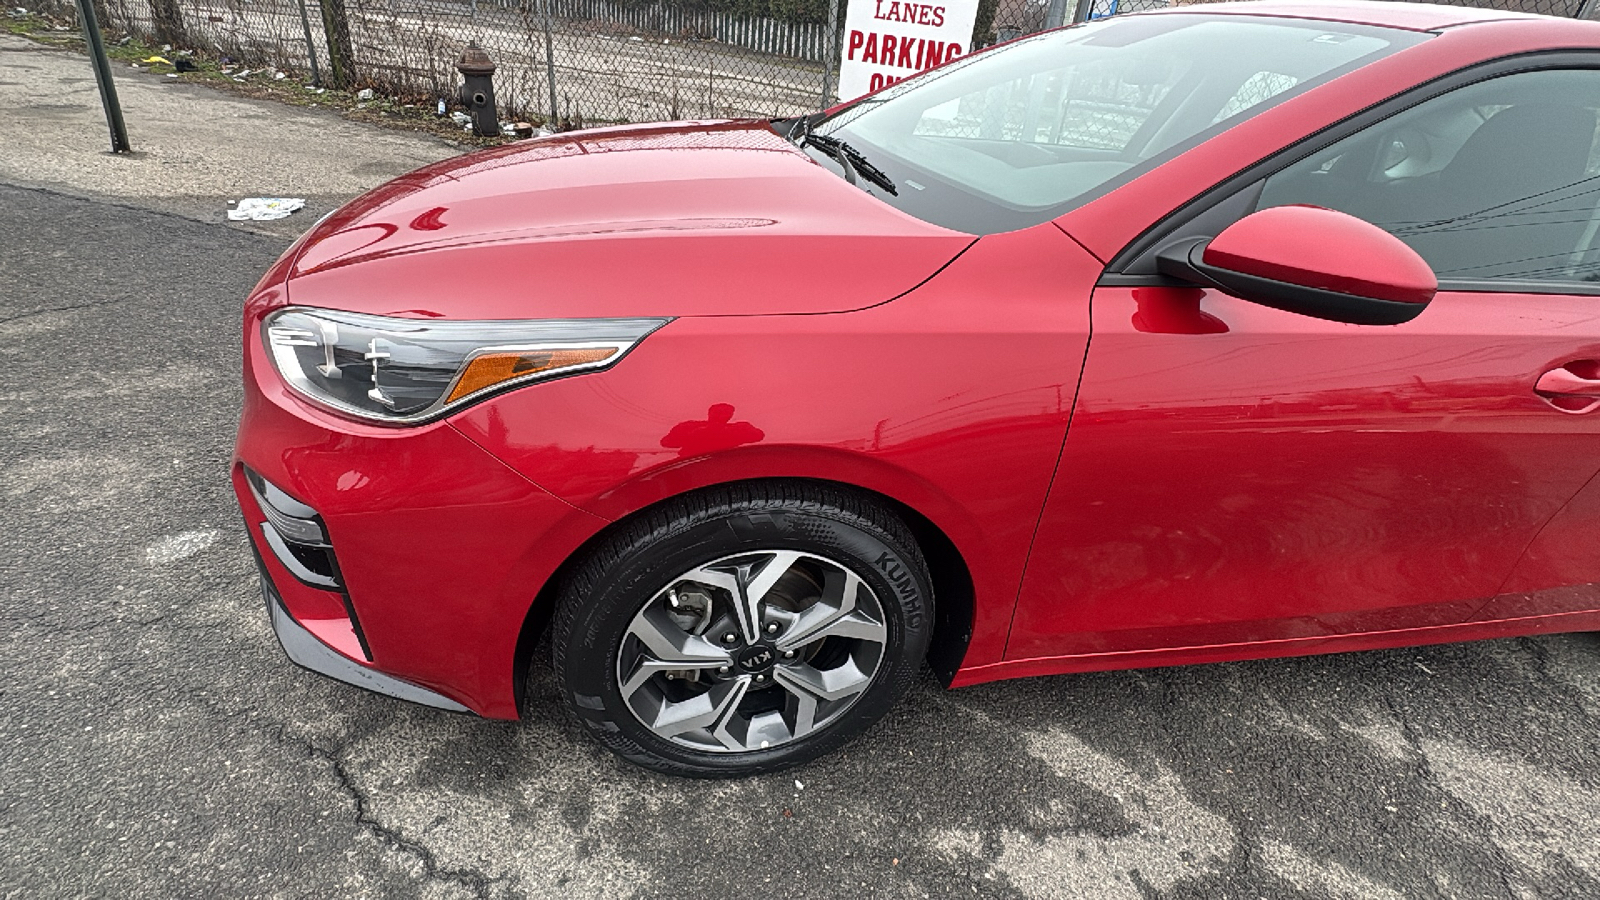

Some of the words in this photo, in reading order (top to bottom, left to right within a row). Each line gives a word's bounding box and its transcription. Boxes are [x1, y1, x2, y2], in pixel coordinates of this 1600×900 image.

[874, 0, 945, 27] LANES
[875, 551, 922, 628] KUMHO
[741, 651, 771, 668] KIA
